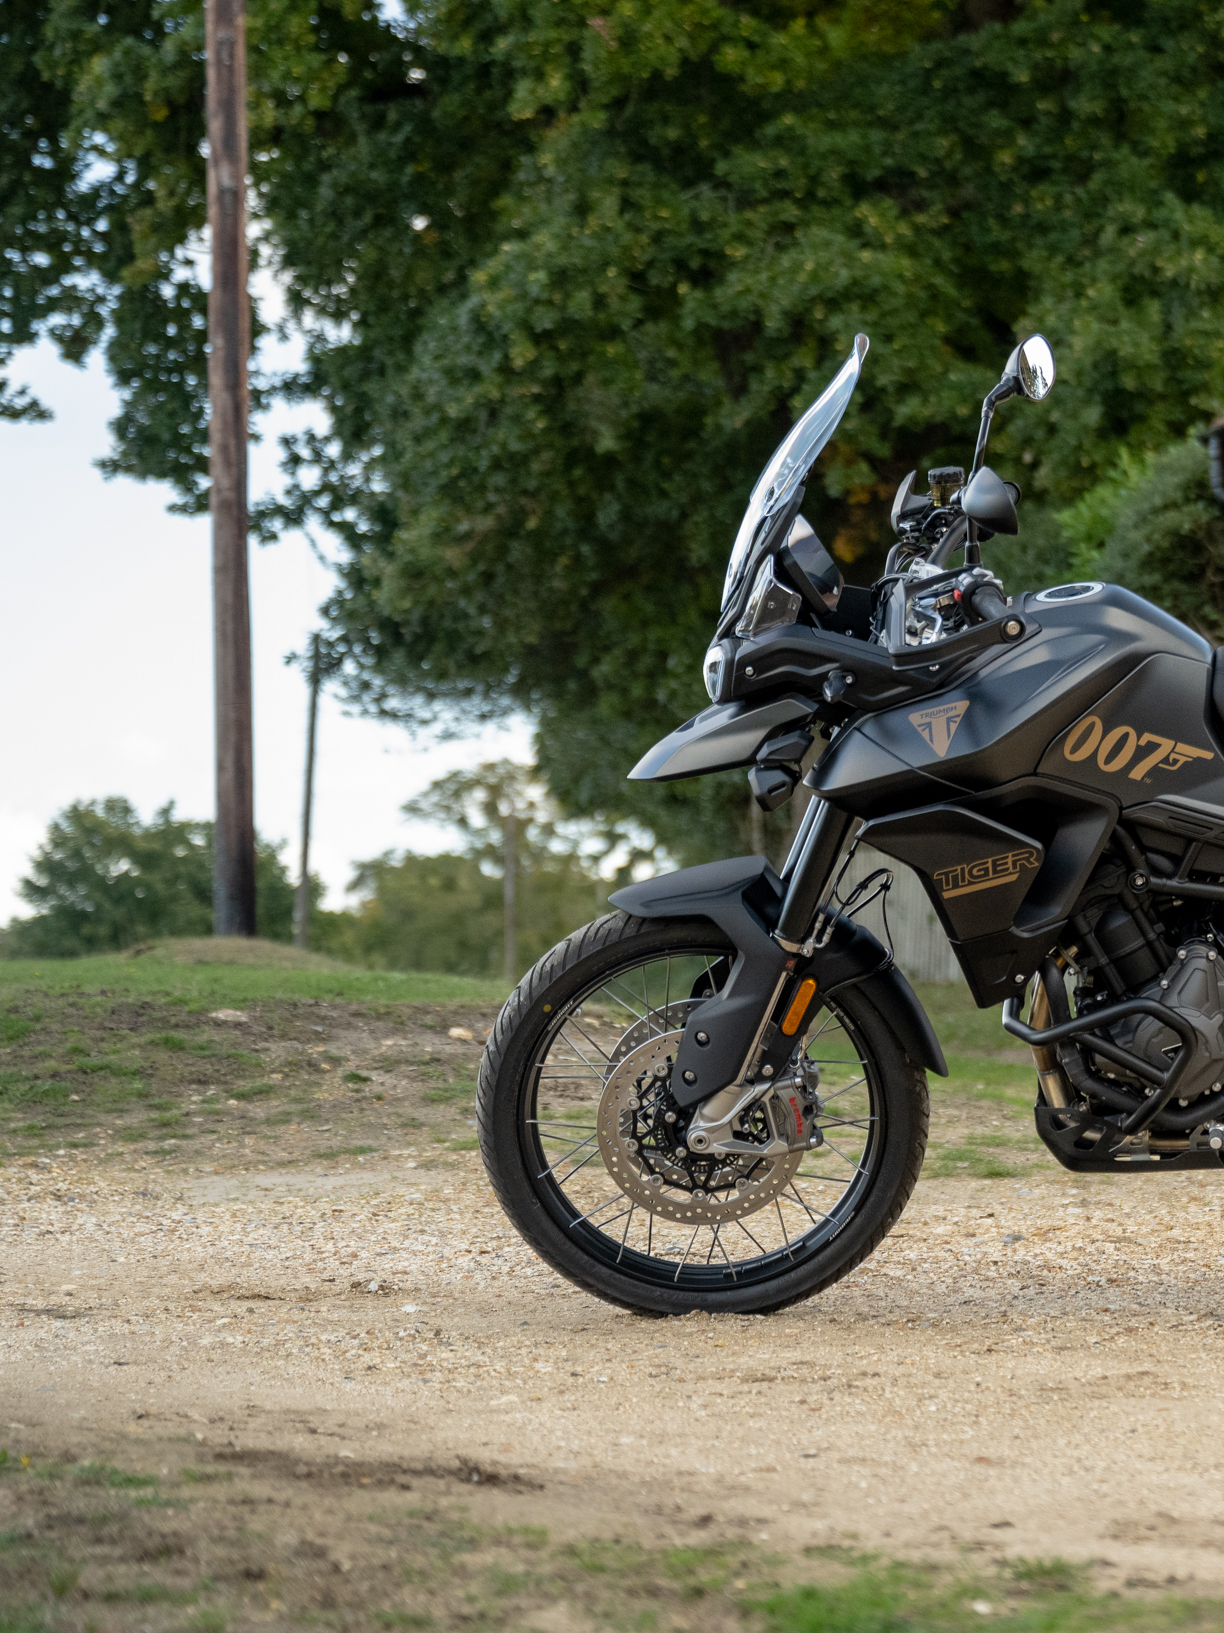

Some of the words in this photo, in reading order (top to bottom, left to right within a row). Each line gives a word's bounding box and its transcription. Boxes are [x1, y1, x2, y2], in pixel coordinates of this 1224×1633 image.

[919, 705, 957, 720] TRIUMPH
[1063, 715, 1176, 781] 007
[933, 848, 1039, 890] TIGER
[789, 1096, 805, 1135] brembo
